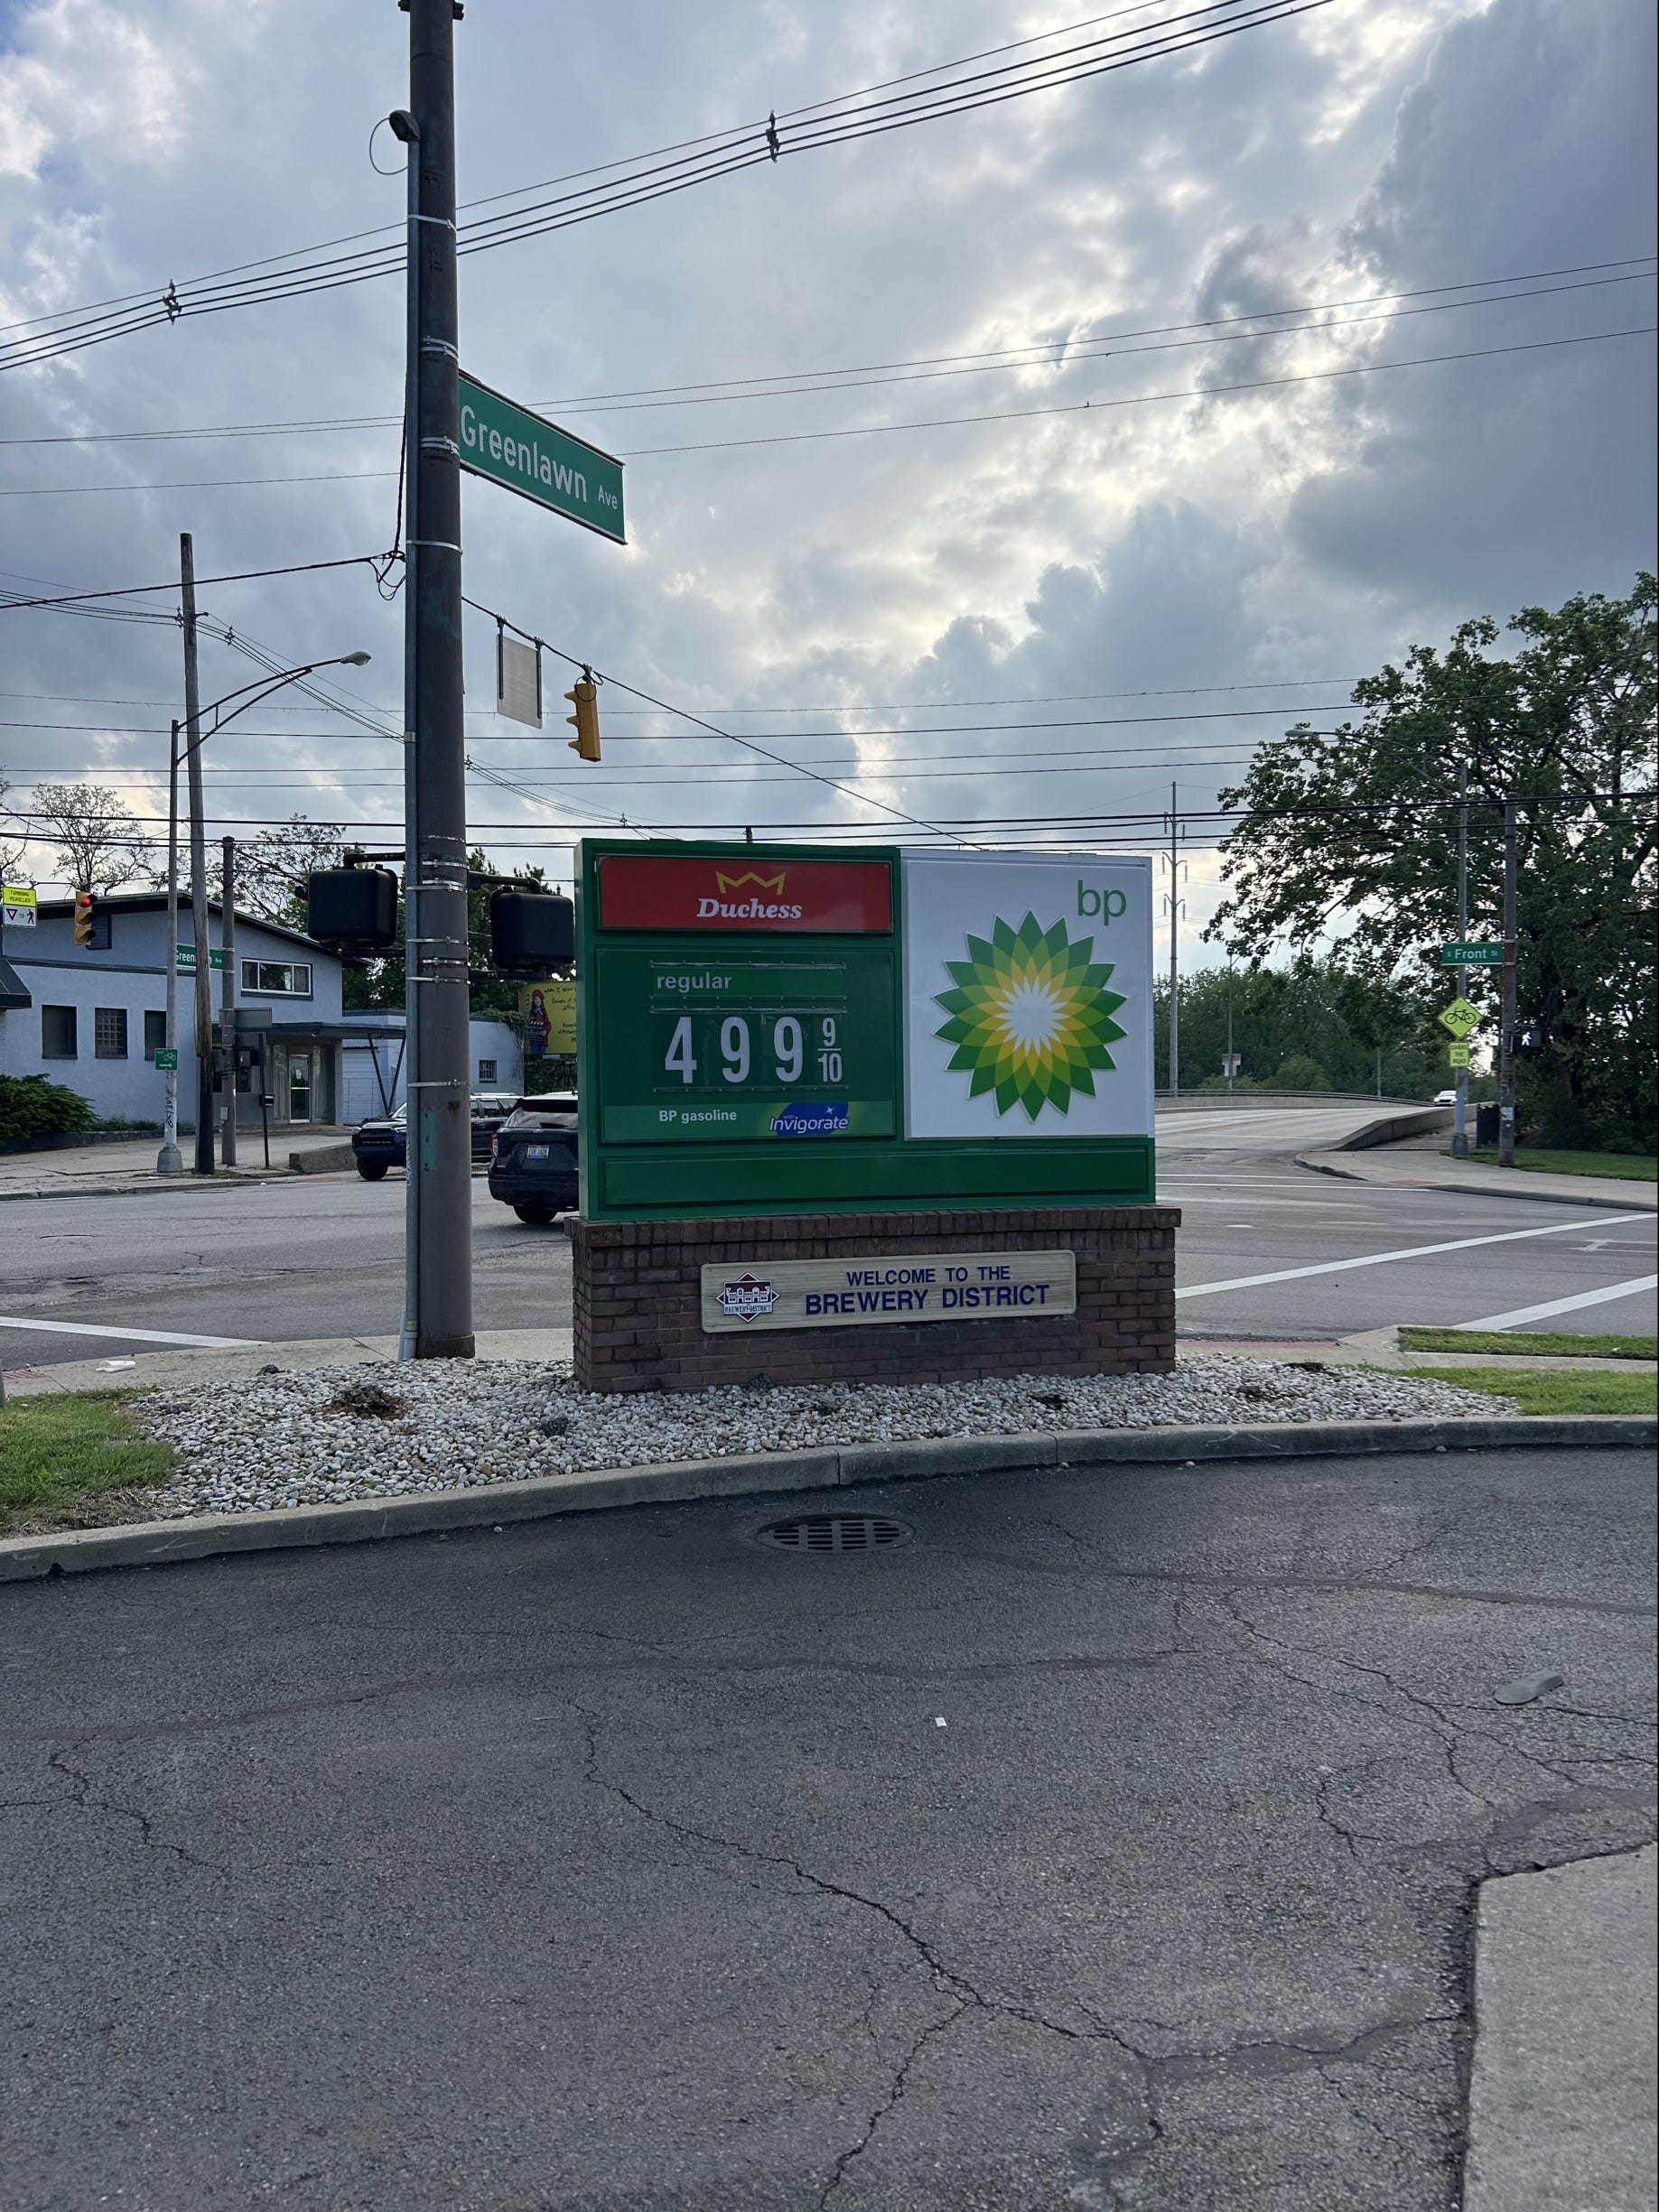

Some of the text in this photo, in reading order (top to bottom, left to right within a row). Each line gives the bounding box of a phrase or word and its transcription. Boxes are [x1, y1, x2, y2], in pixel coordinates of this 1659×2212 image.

[461, 405, 618, 510] Greenlawn Ave
[696, 897, 803, 919] Duchess
[1077, 879, 1127, 926] bp
[1455, 948, 1487, 959] Front
[657, 971, 732, 993] regular
[658, 1110, 737, 1124] BP gasoline
[769, 1116, 848, 1134] Invigorate
[846, 1266, 1011, 1286] WELCOME TO THE
[806, 1284, 1049, 1315] BREWERY DISTRICT
